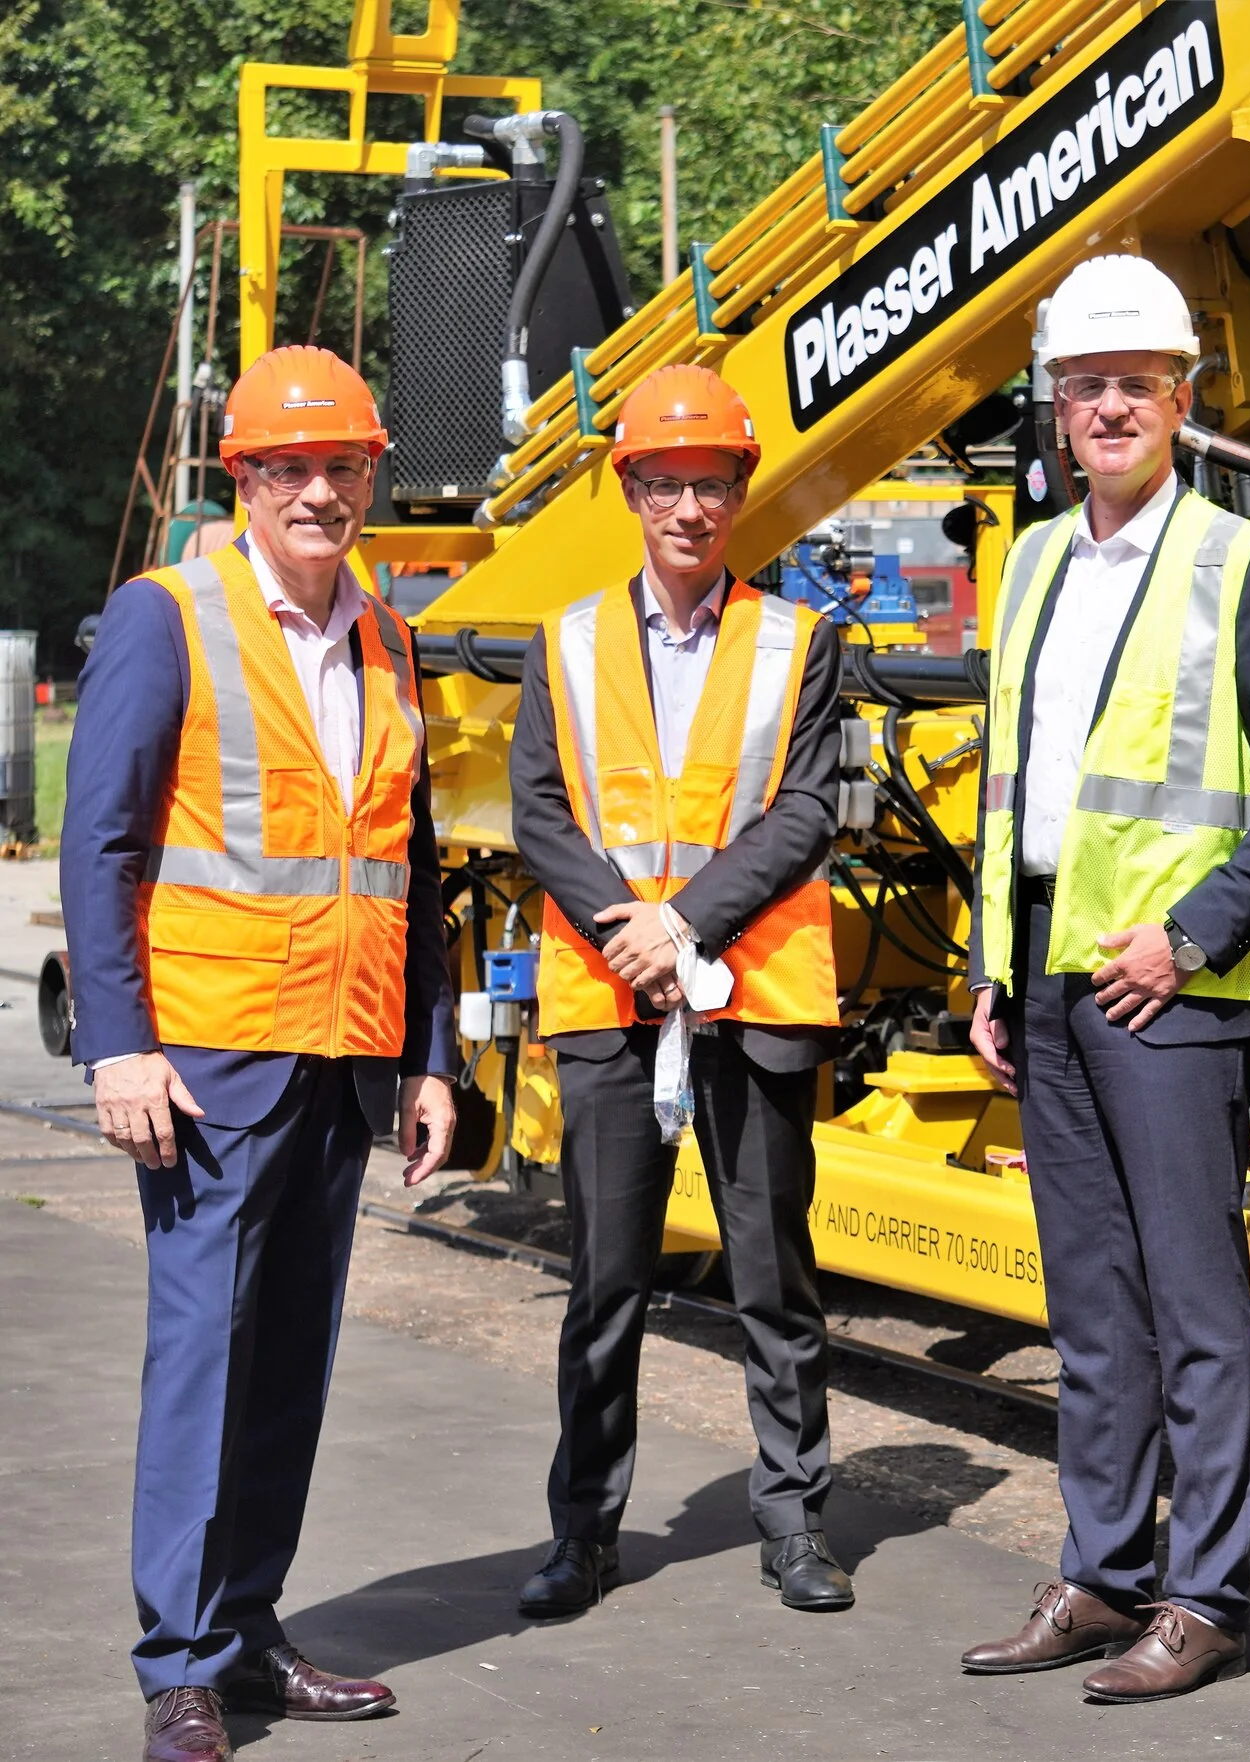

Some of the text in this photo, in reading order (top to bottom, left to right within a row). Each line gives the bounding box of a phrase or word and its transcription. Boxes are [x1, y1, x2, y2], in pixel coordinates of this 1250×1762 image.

[792, 18, 1215, 411] Plasser American
[826, 1202, 860, 1237] AND
[865, 1211, 941, 1260] CARRIER
[946, 1231, 998, 1273] 70,500
[1004, 1245, 1043, 1286] LBS.
